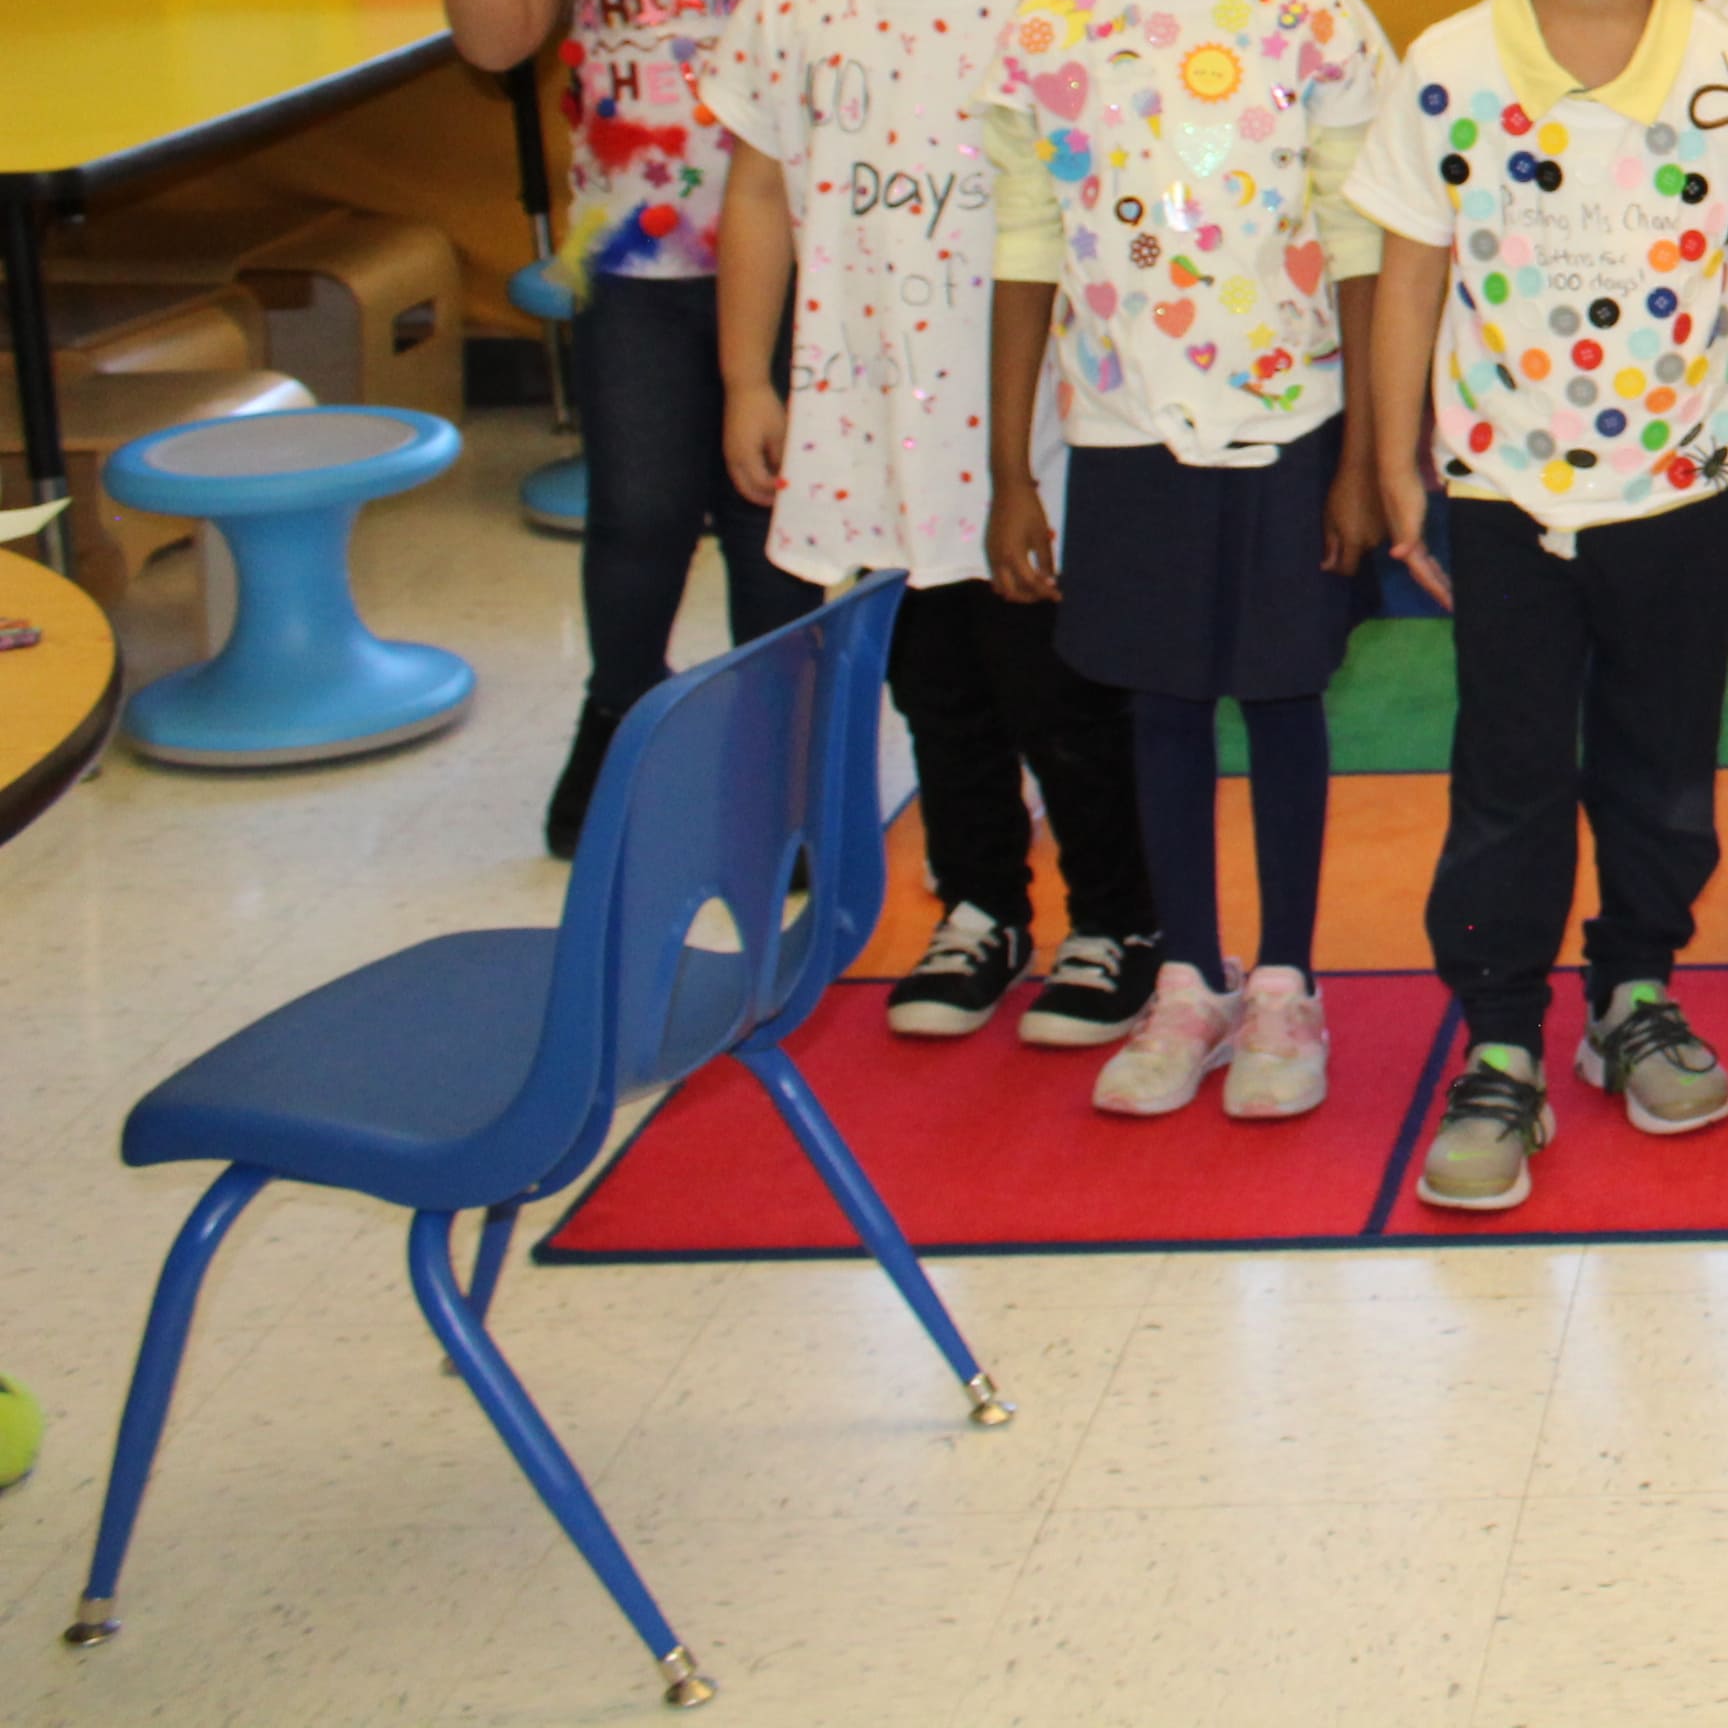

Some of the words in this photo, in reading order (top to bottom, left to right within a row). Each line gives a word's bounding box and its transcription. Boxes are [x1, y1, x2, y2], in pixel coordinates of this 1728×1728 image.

[850, 161, 992, 239] Days
[901, 252, 969, 308] of
[1547, 272, 1582, 291] 100
